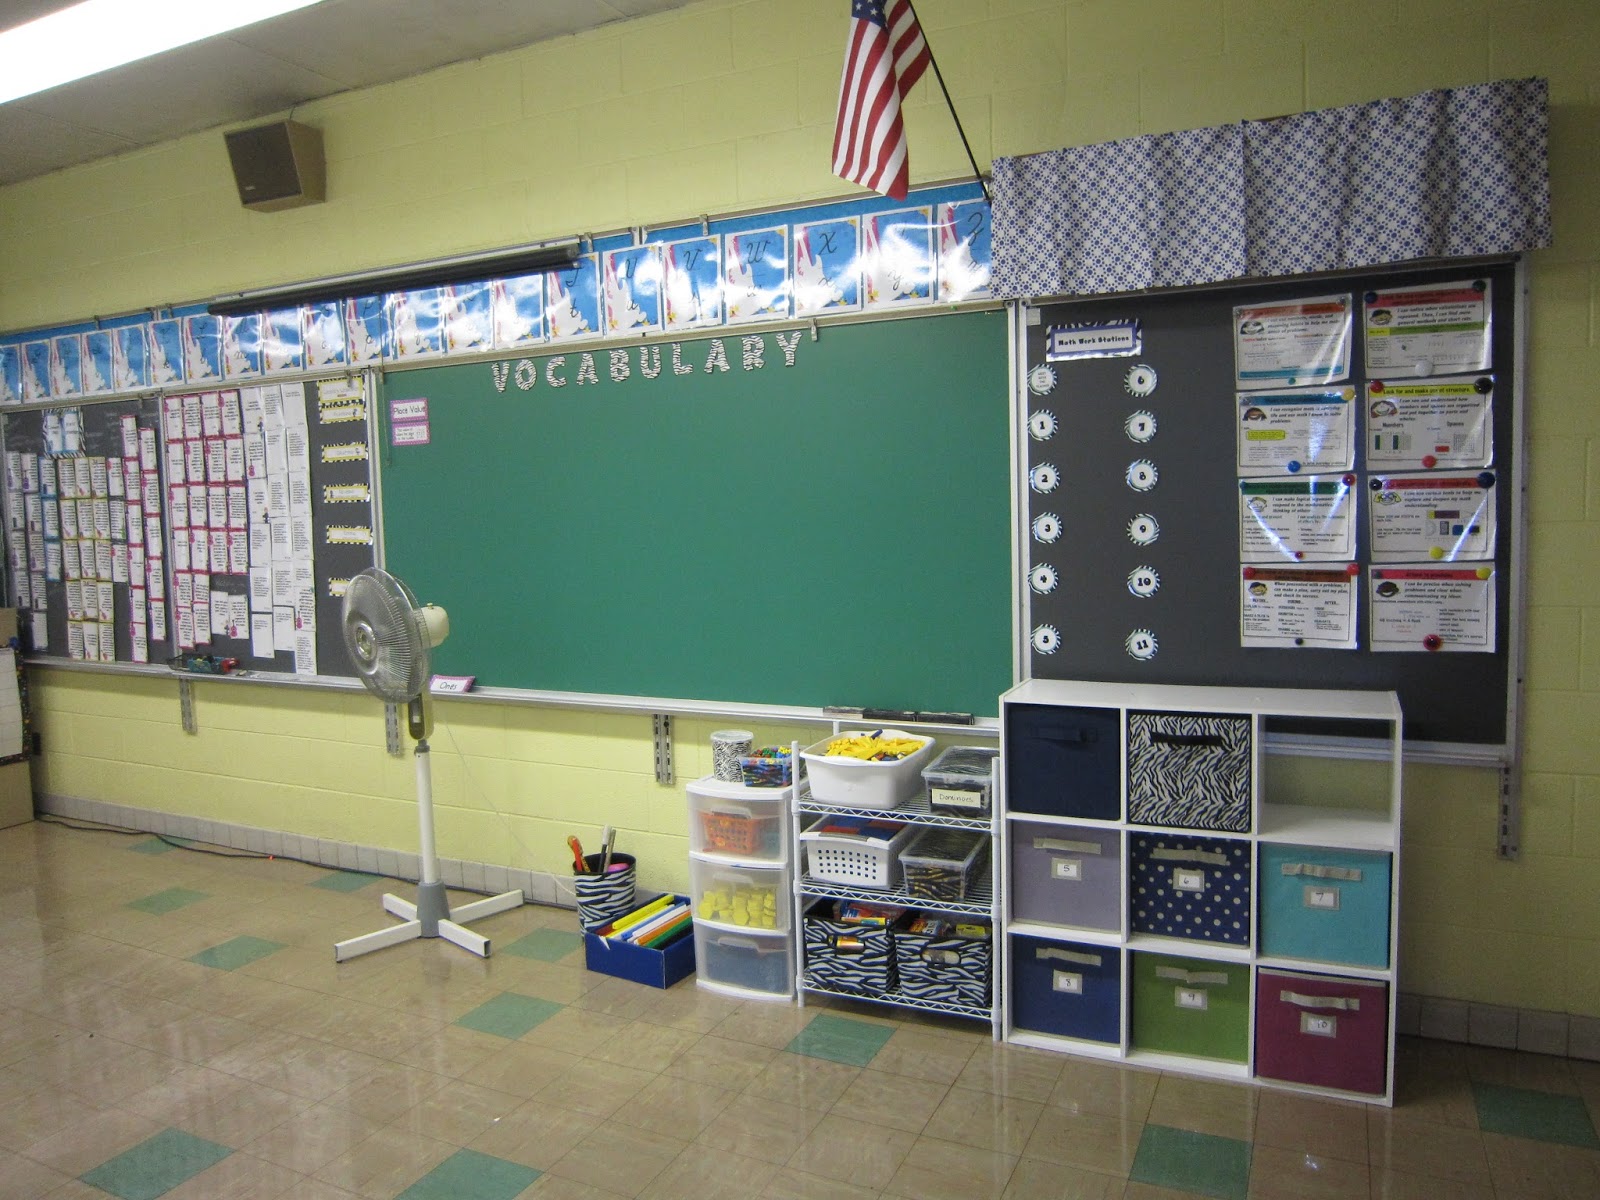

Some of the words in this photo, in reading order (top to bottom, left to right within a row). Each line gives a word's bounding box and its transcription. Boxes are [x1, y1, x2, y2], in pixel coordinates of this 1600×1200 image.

[818, 232, 837, 255] X
[746, 240, 770, 264] W
[684, 248, 702, 272] V
[626, 258, 638, 278] U
[1058, 338, 1076, 346] Math
[490, 331, 802, 393] VOCABULARY
[1137, 376, 1145, 384] 6
[1040, 421, 1045, 430] 1
[1139, 423, 1145, 431] 7
[1042, 474, 1048, 483] 2
[1139, 472, 1146, 480] 8
[1045, 524, 1051, 532] 3
[1140, 525, 1146, 533] 9
[1040, 575, 1047, 583] 4
[1138, 578, 1151, 586] 10
[1042, 636, 1049, 644] 5
[1137, 639, 1149, 650] 11
[440, 682, 458, 690] Ones
[940, 793, 973, 803] Dominoes
[1063, 864, 1070, 873] 5
[1316, 893, 1324, 902] 7
[1066, 978, 1071, 987] 8
[1317, 1021, 1327, 1029] 10
